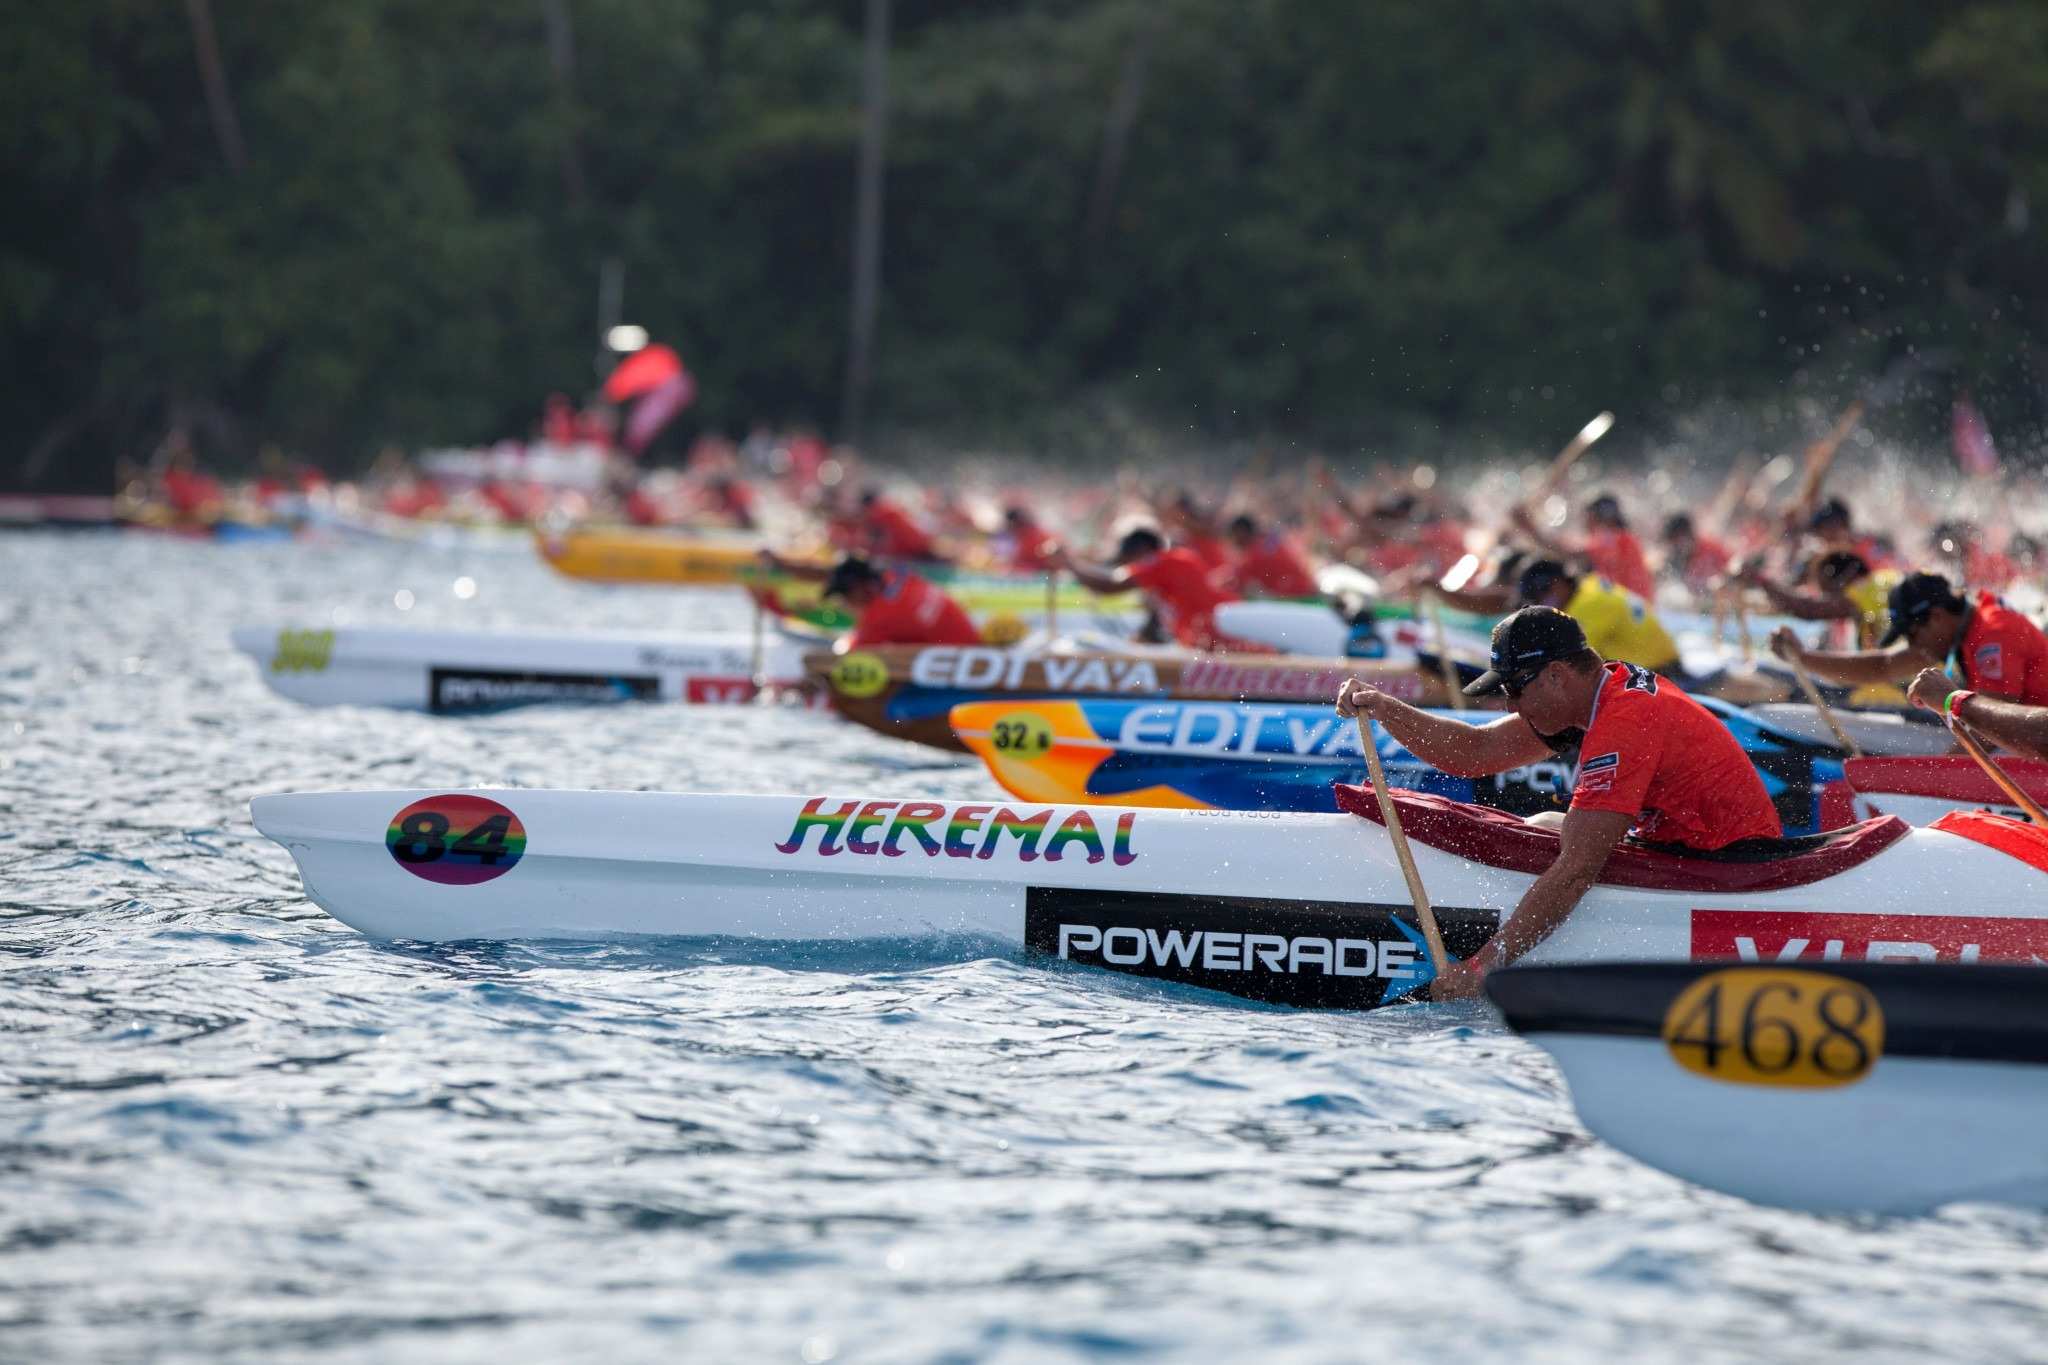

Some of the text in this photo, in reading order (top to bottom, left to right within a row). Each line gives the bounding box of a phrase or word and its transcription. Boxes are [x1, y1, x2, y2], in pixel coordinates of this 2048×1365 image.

[911, 647, 1030, 689] EDT
[1042, 656, 1159, 690] VA'A
[994, 720, 1027, 751] 32
[1119, 703, 1412, 757] EDT VA'
[393, 811, 511, 865] 84
[775, 797, 1139, 866] HEREMAI
[1058, 923, 1418, 979] POWERADE
[1667, 980, 1873, 1077] 468
